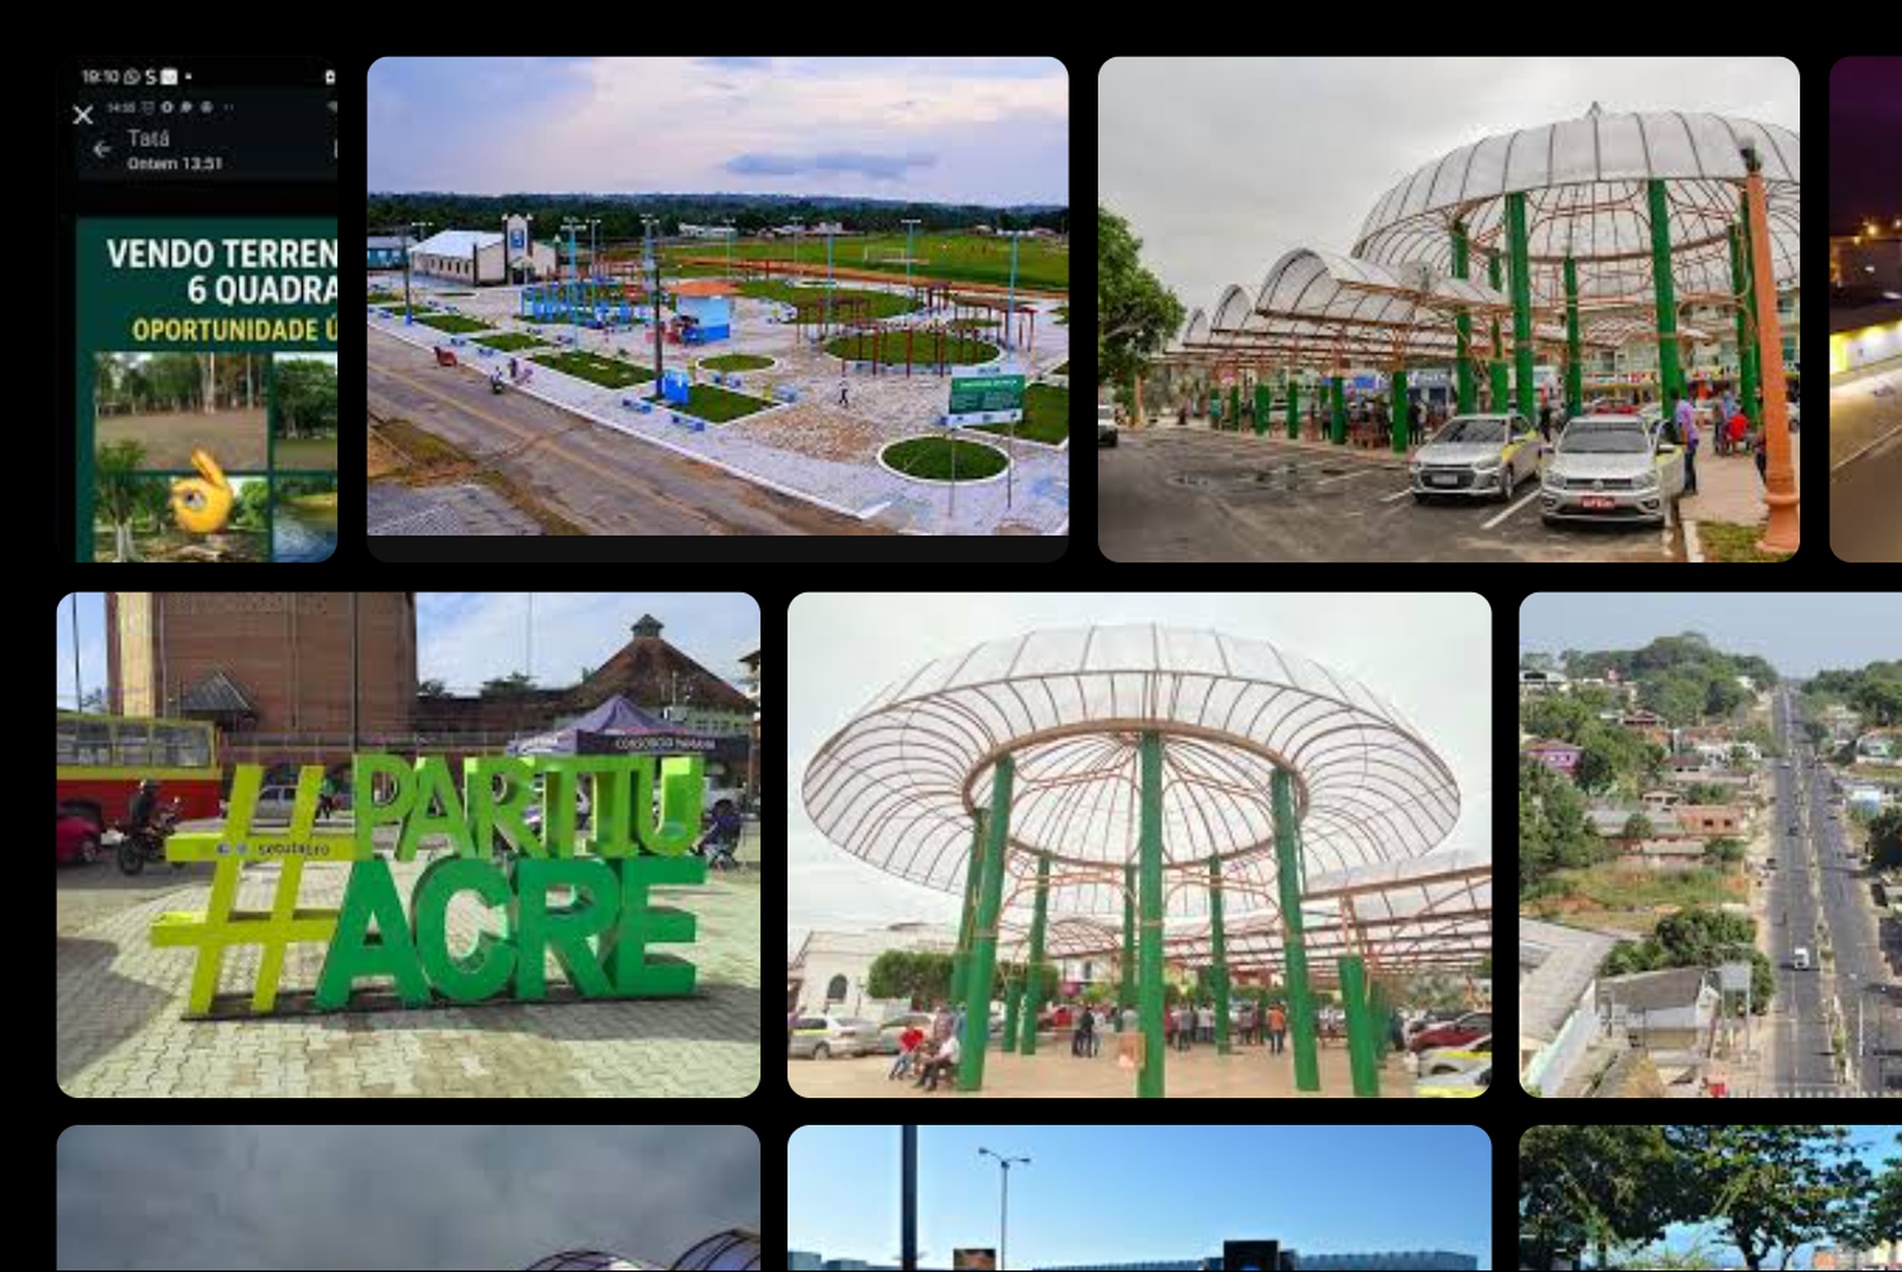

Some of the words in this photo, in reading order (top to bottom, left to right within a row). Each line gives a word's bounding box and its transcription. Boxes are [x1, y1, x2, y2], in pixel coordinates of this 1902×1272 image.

[106, 239, 214, 268] VENDO
[222, 239, 338, 268] TERREN
[187, 275, 206, 304] 6
[132, 318, 319, 341] OPORTUNIDADE
[353, 753, 705, 861] PARTIU
[313, 856, 709, 1010] ACRE
